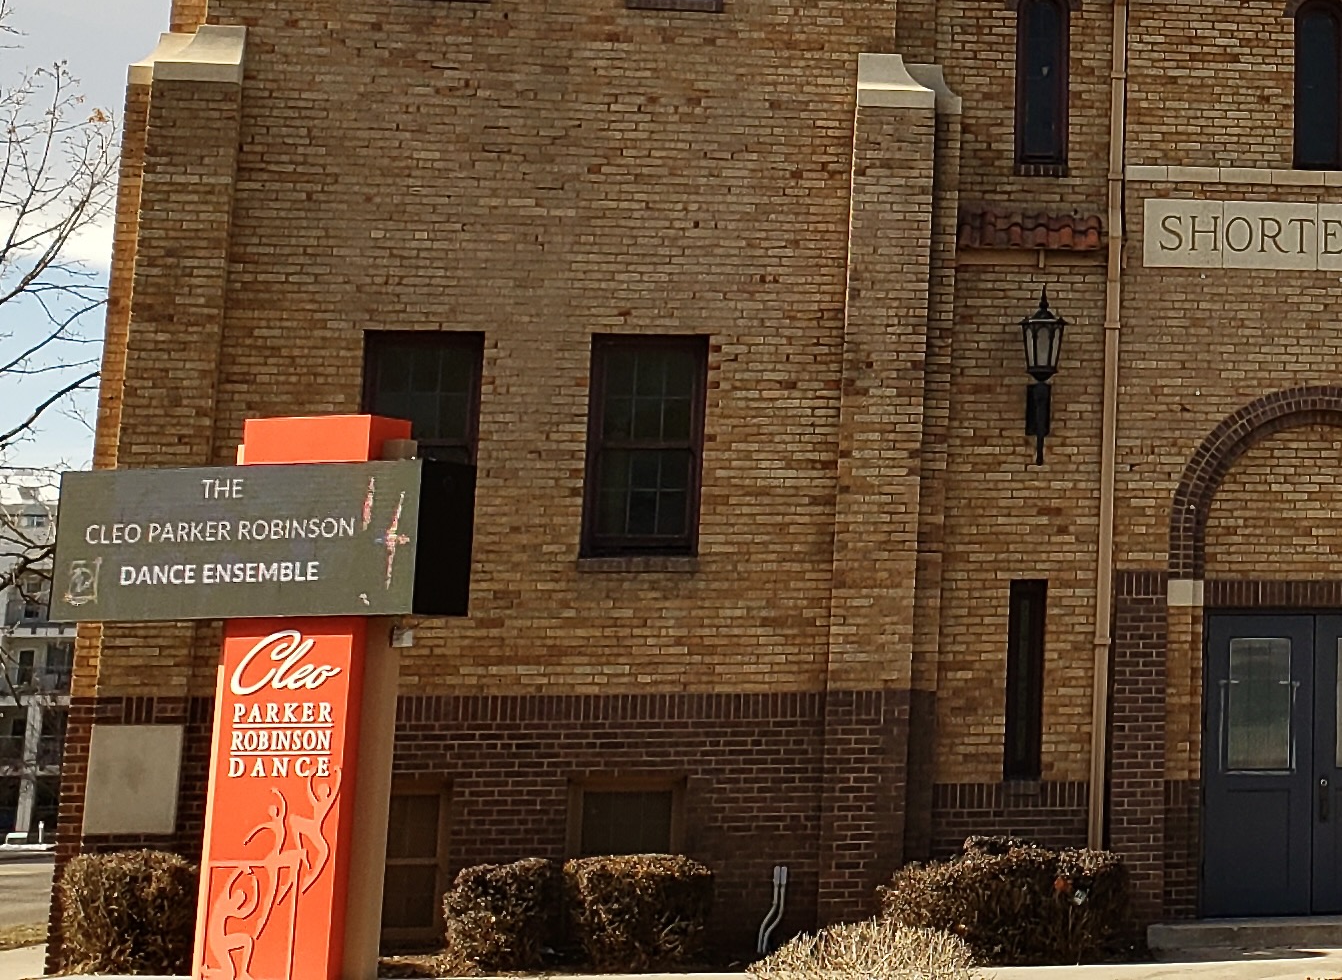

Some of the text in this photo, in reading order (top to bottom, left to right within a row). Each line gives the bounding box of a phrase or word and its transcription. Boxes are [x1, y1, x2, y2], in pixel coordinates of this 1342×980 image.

[201, 478, 245, 499] THE
[85, 517, 355, 545] CLEO PARKER ROBINSON
[119, 561, 320, 586] DANCE ENSEMBLE
[230, 629, 342, 696] Cleo
[232, 702, 333, 724] PARKER
[230, 729, 331, 753] ROBINSON
[227, 756, 331, 778] DANCE
